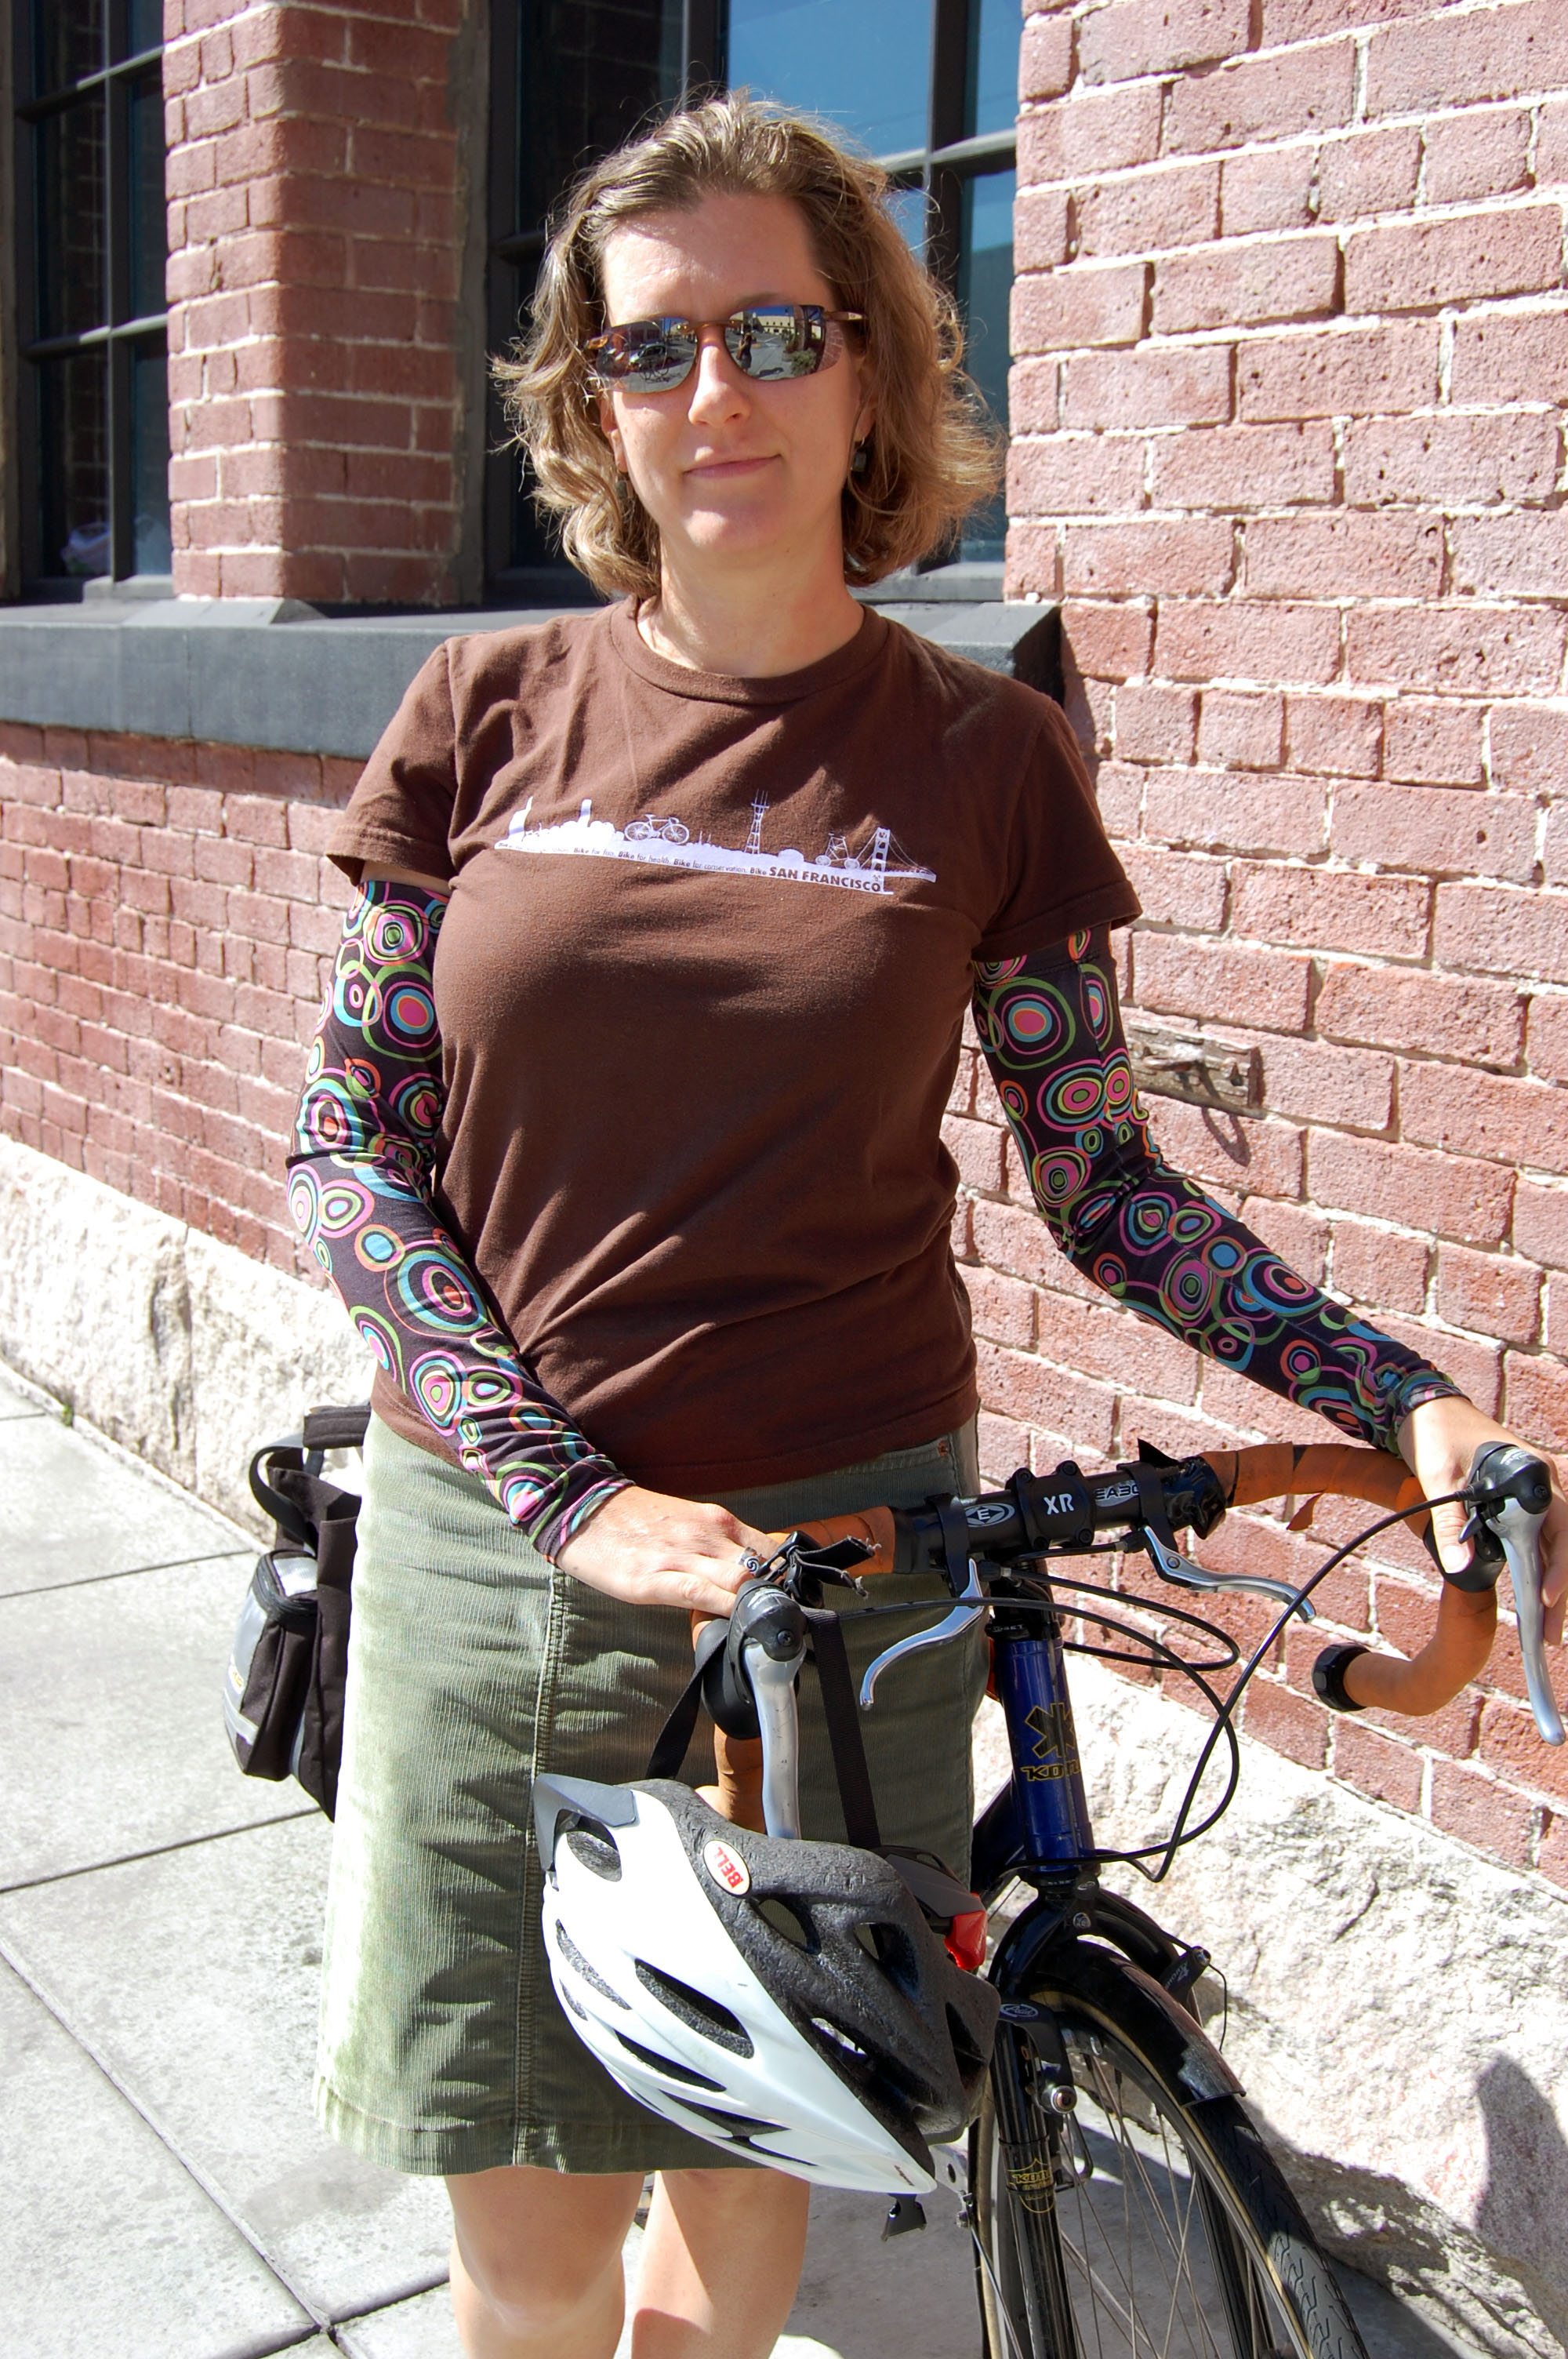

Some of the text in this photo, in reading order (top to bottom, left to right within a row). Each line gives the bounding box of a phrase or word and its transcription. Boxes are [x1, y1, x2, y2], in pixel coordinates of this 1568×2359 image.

[618, 851, 634, 860] Bike
[673, 858, 691, 867] Bike
[692, 860, 702, 869] for
[750, 867, 767, 875] Bike
[769, 866, 798, 880] SAN
[802, 870, 881, 892] FRANCISCO
[1043, 1493, 1075, 1515] XR
[714, 1846, 744, 1888] BELL
